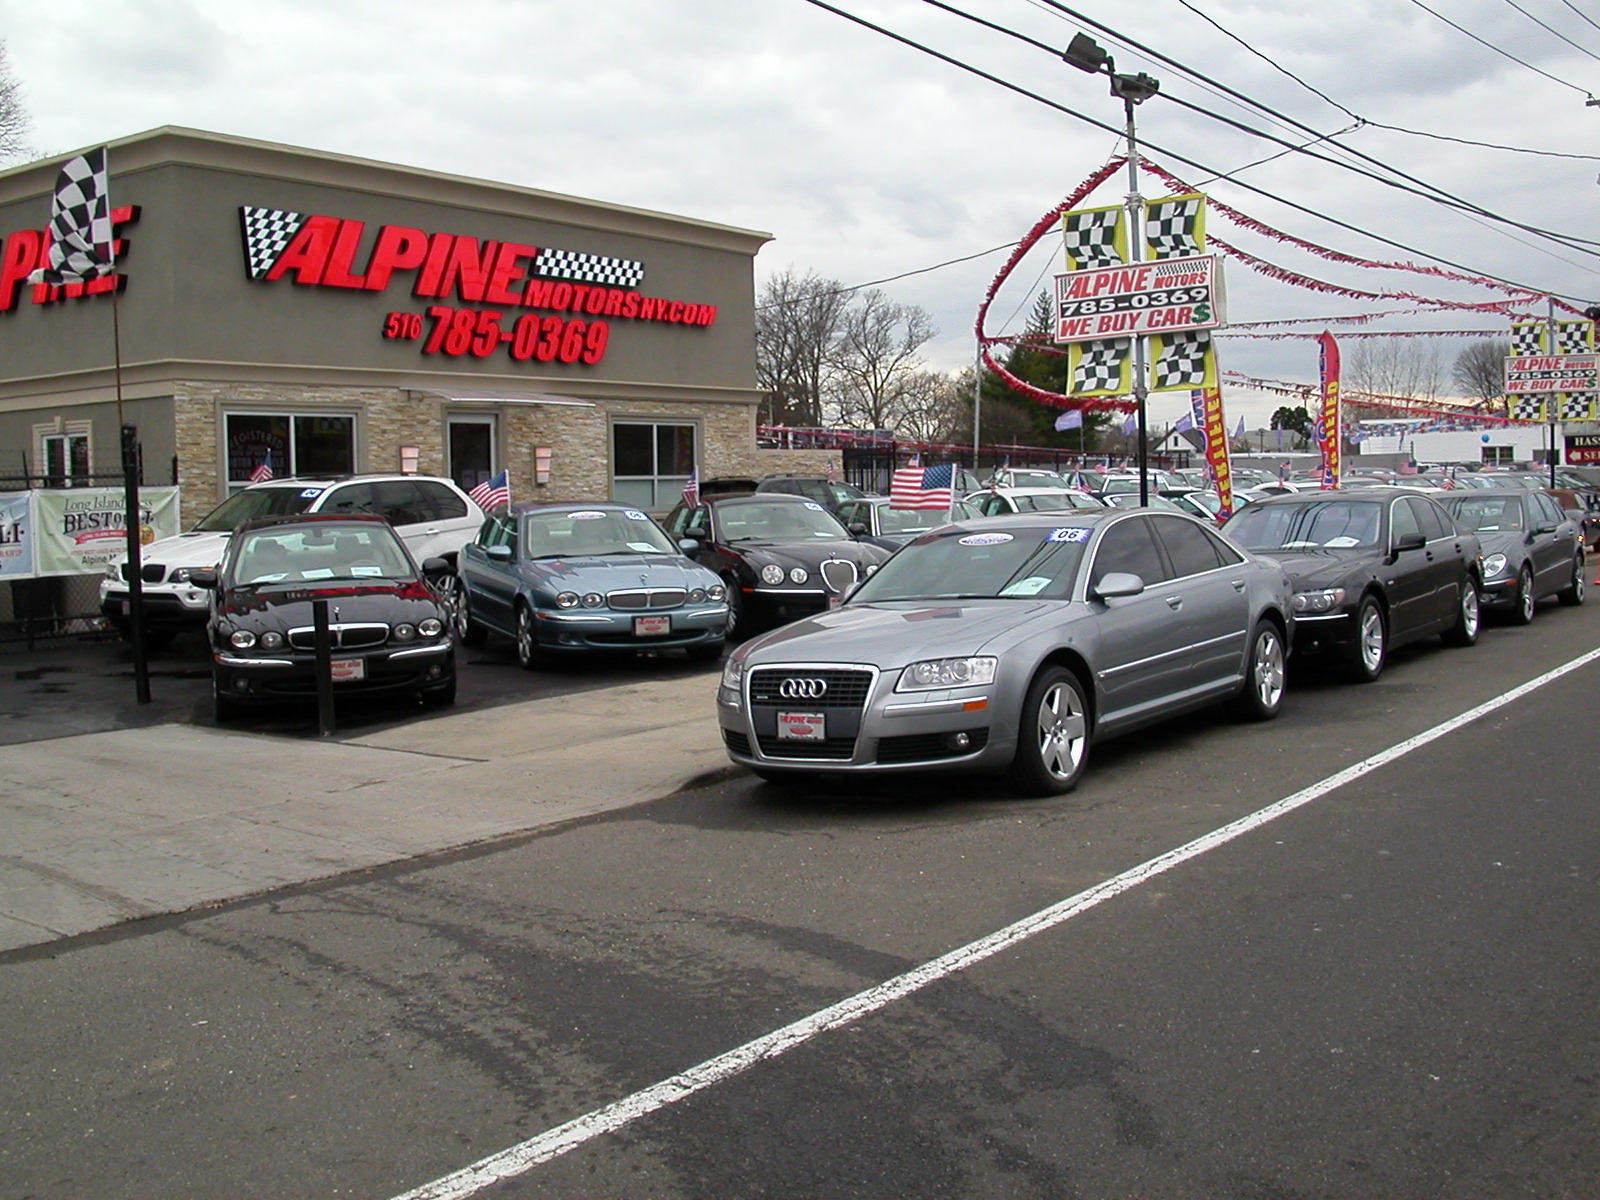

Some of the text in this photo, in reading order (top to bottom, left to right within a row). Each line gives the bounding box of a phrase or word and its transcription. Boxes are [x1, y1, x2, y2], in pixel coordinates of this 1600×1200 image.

[264, 214, 539, 306] ALPINE
[1064, 268, 1207, 299] ALPINE MOTORS
[1062, 287, 1207, 316] 785-0369
[383, 305, 609, 364] 516 785-0369
[1060, 317, 1094, 337] WE
[1097, 311, 1142, 333] BUY
[1509, 369, 1596, 380] 785-0369
[1511, 357, 1564, 371] ALPINE
[1508, 380, 1527, 391] WE
[1530, 379, 1556, 390] BUY
[64, 498, 91, 512] Long
[63, 512, 112, 535] BEST
[1058, 530, 1079, 539] 06
